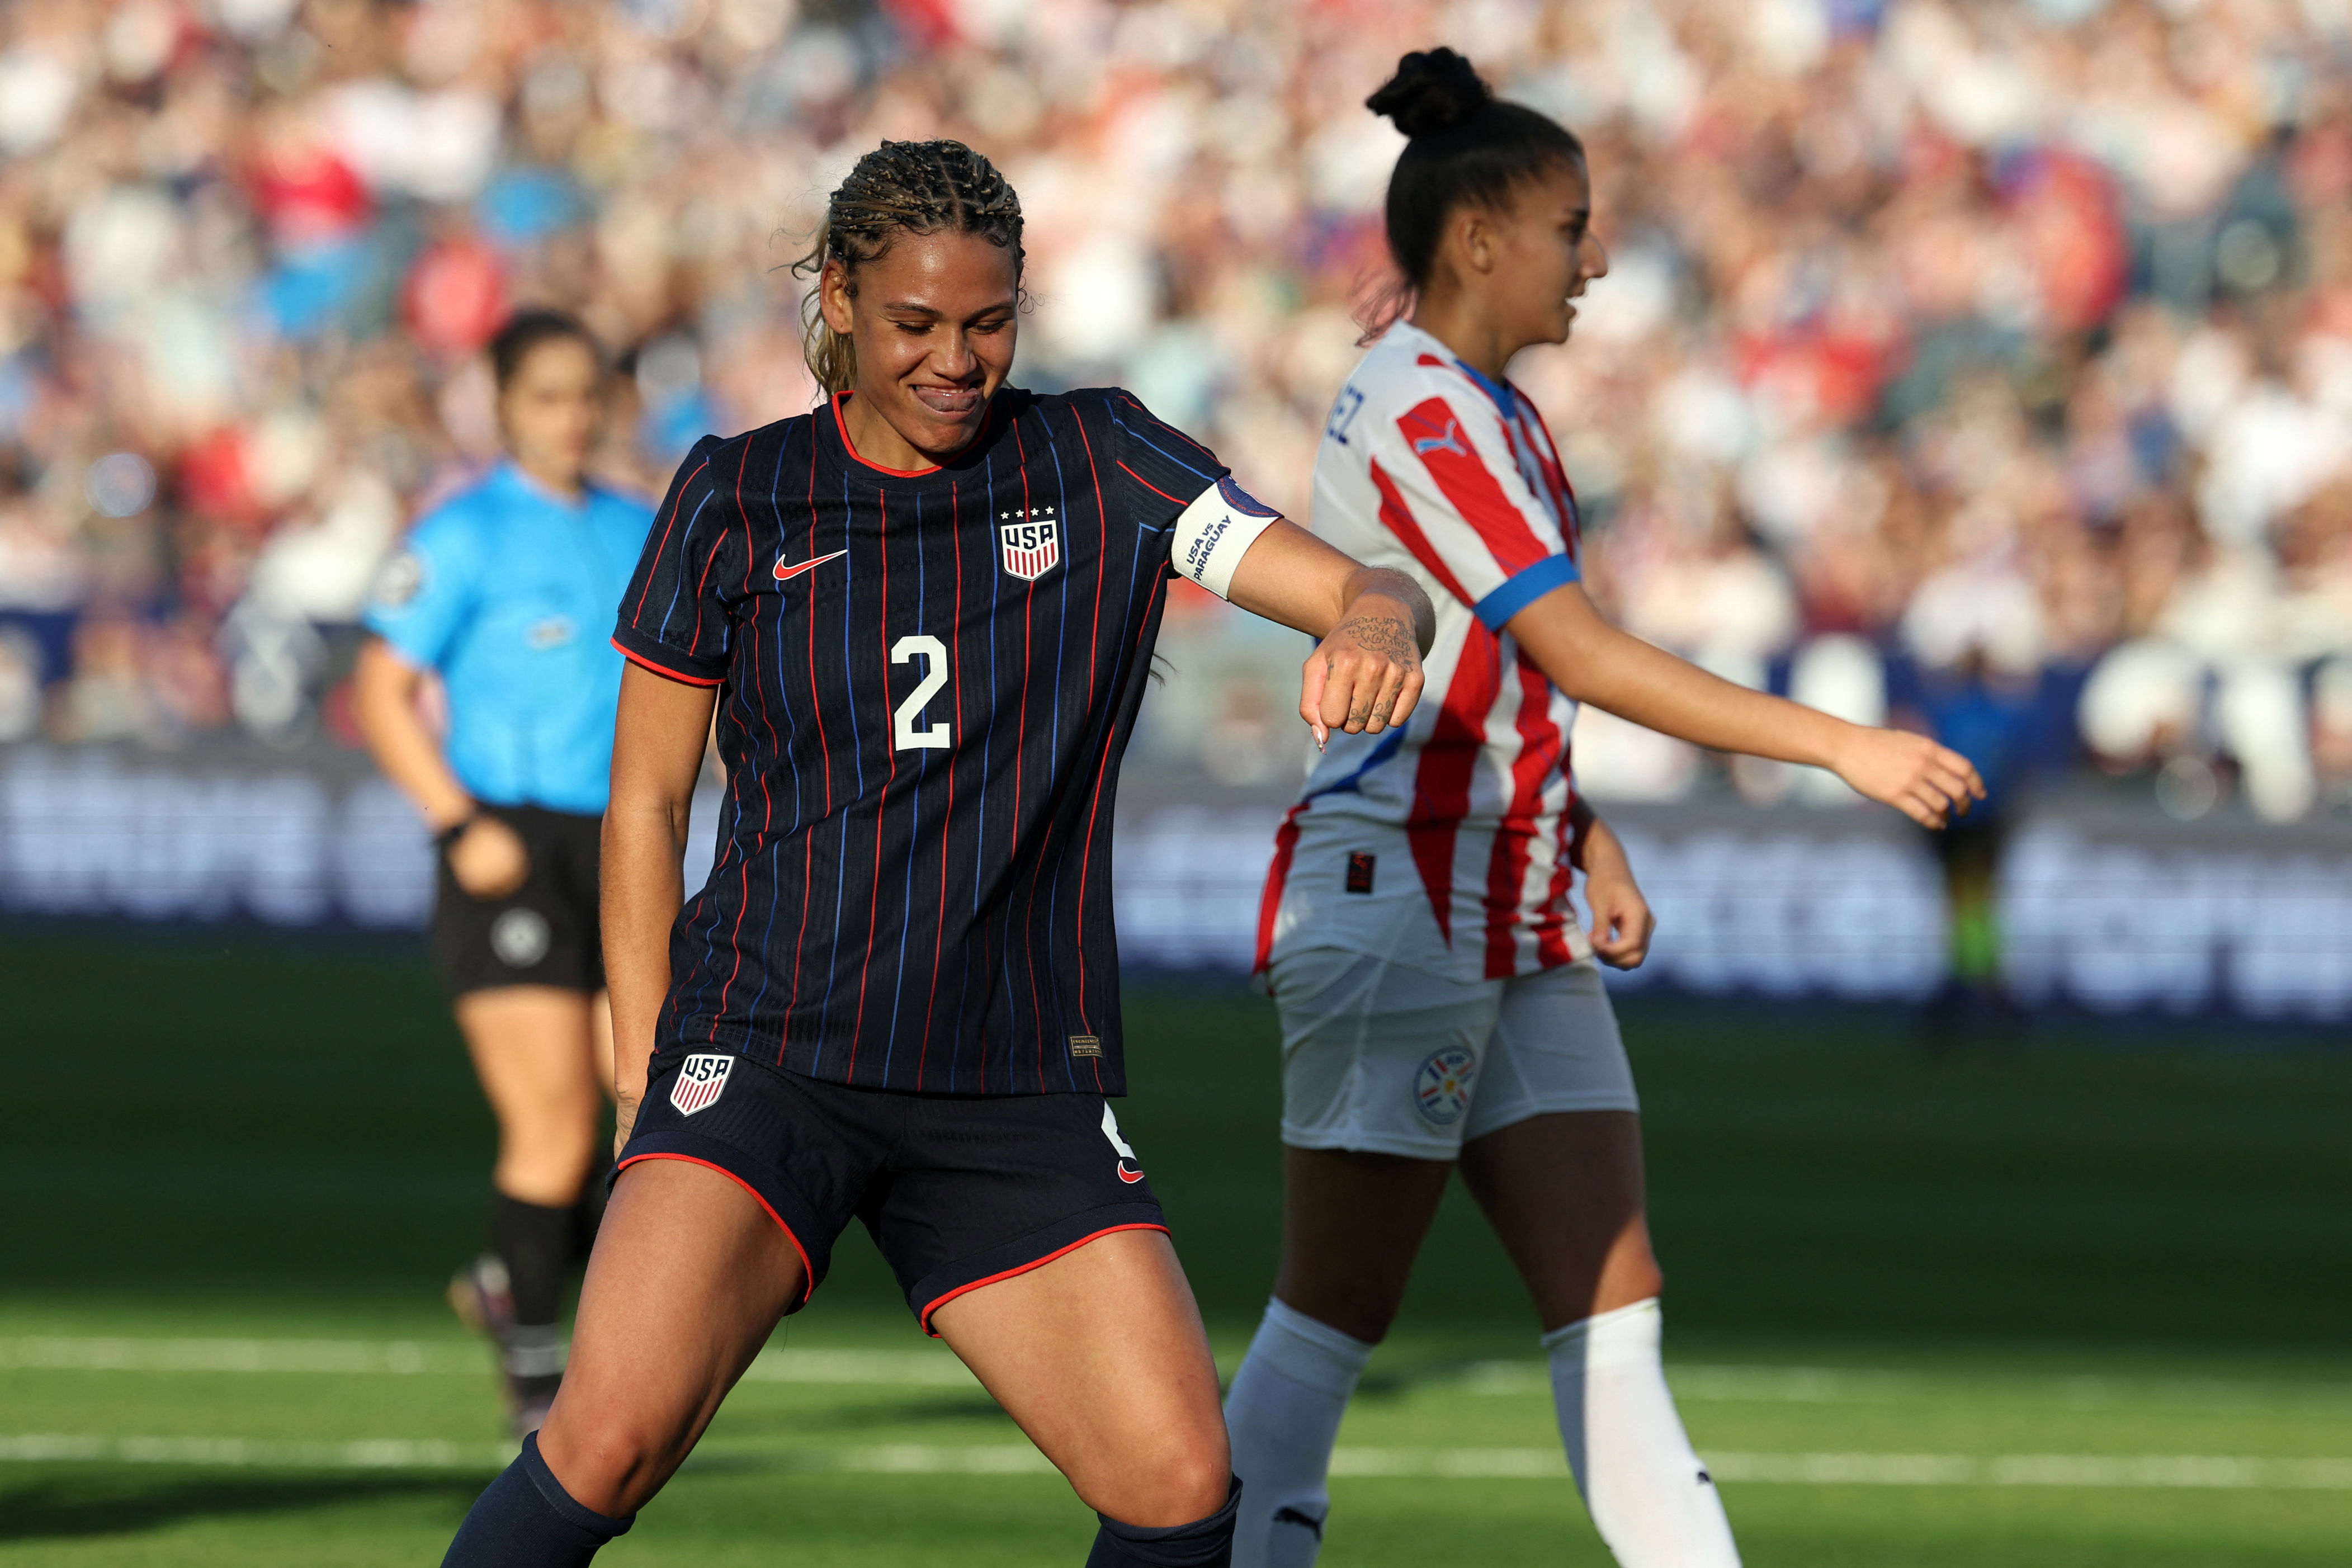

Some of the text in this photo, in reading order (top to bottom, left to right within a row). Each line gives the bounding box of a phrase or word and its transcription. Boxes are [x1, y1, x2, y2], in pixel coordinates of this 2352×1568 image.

[1005, 524, 1054, 550] USA
[1194, 514, 1232, 581] PARAGUAY
[1187, 539, 1204, 564] USA
[891, 635, 950, 751] 2
[684, 1058, 730, 1082] USA
